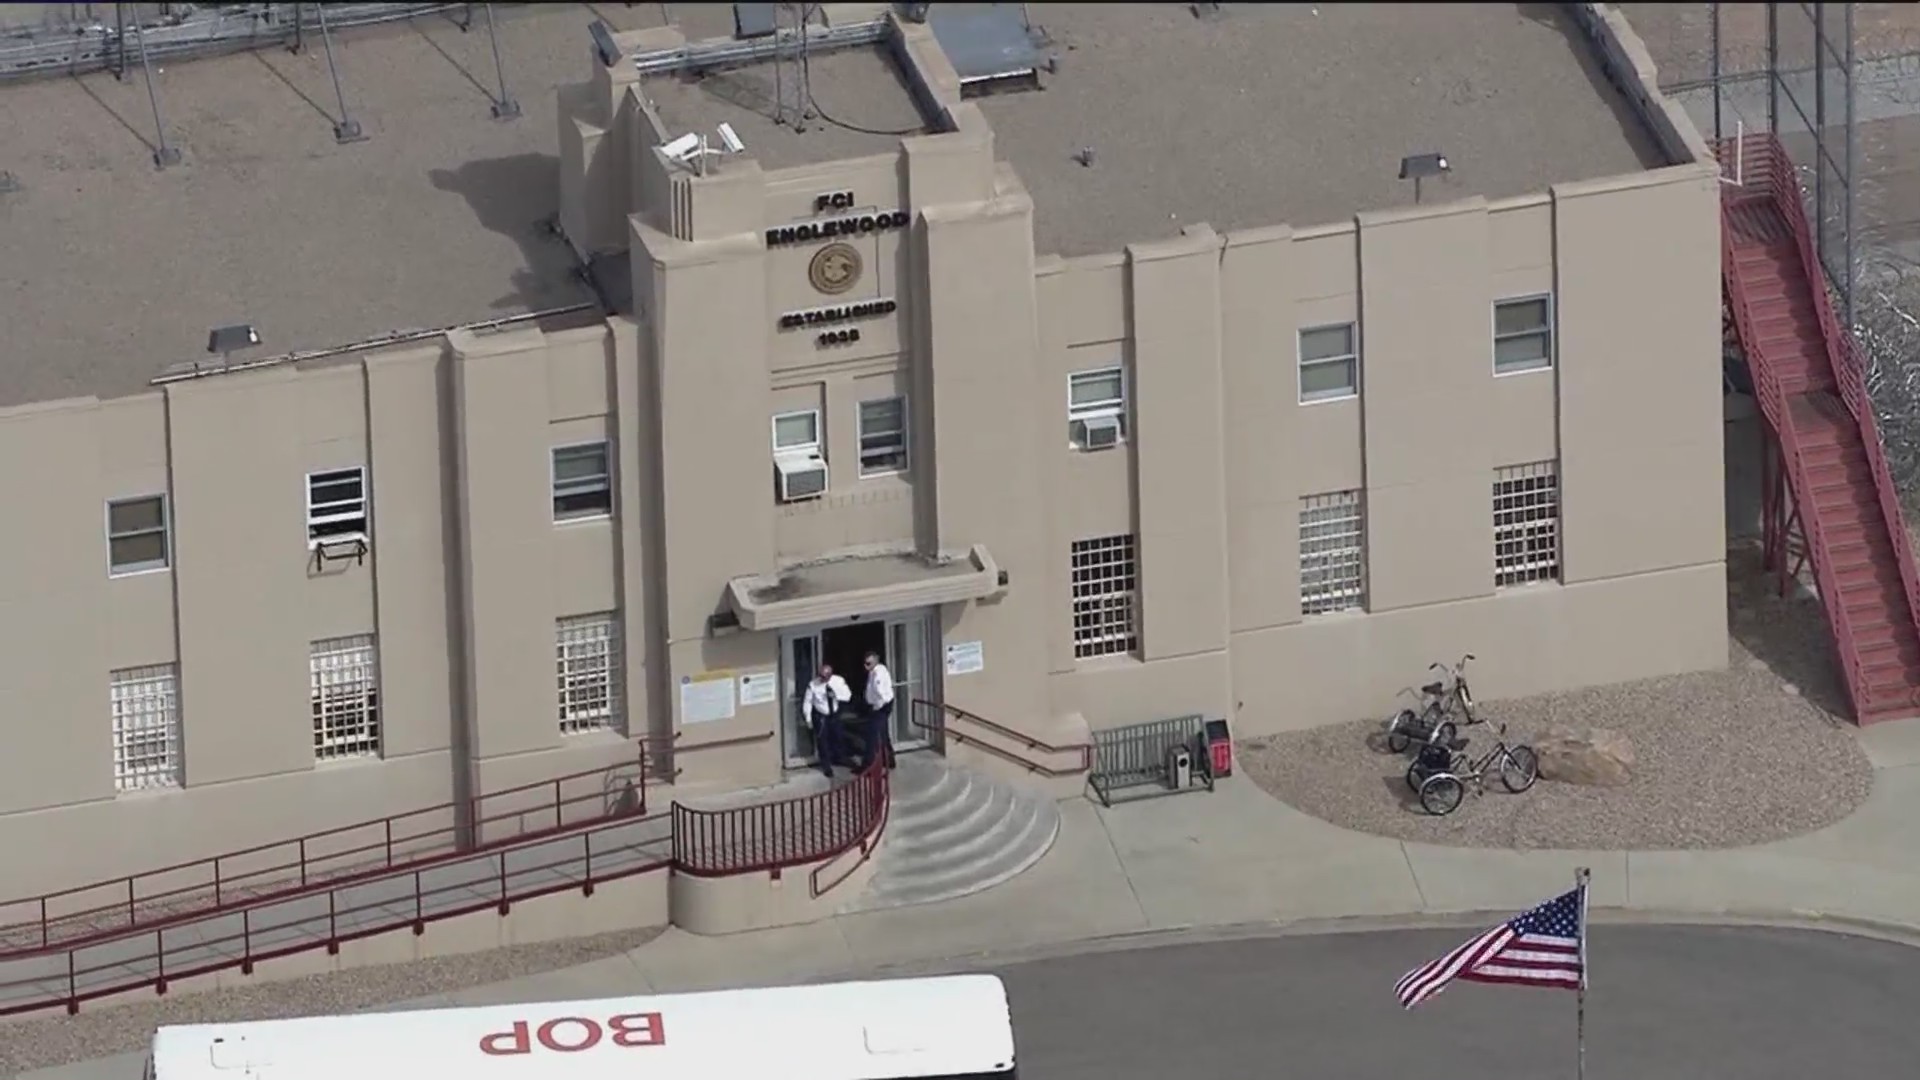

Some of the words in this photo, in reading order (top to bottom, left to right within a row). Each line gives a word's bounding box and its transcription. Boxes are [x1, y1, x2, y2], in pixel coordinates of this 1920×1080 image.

[816, 192, 854, 211] FCI
[766, 211, 910, 246] ENGLEWOOD
[780, 301, 896, 328] ESTABLISHED
[480, 1012, 664, 1054] BOP
